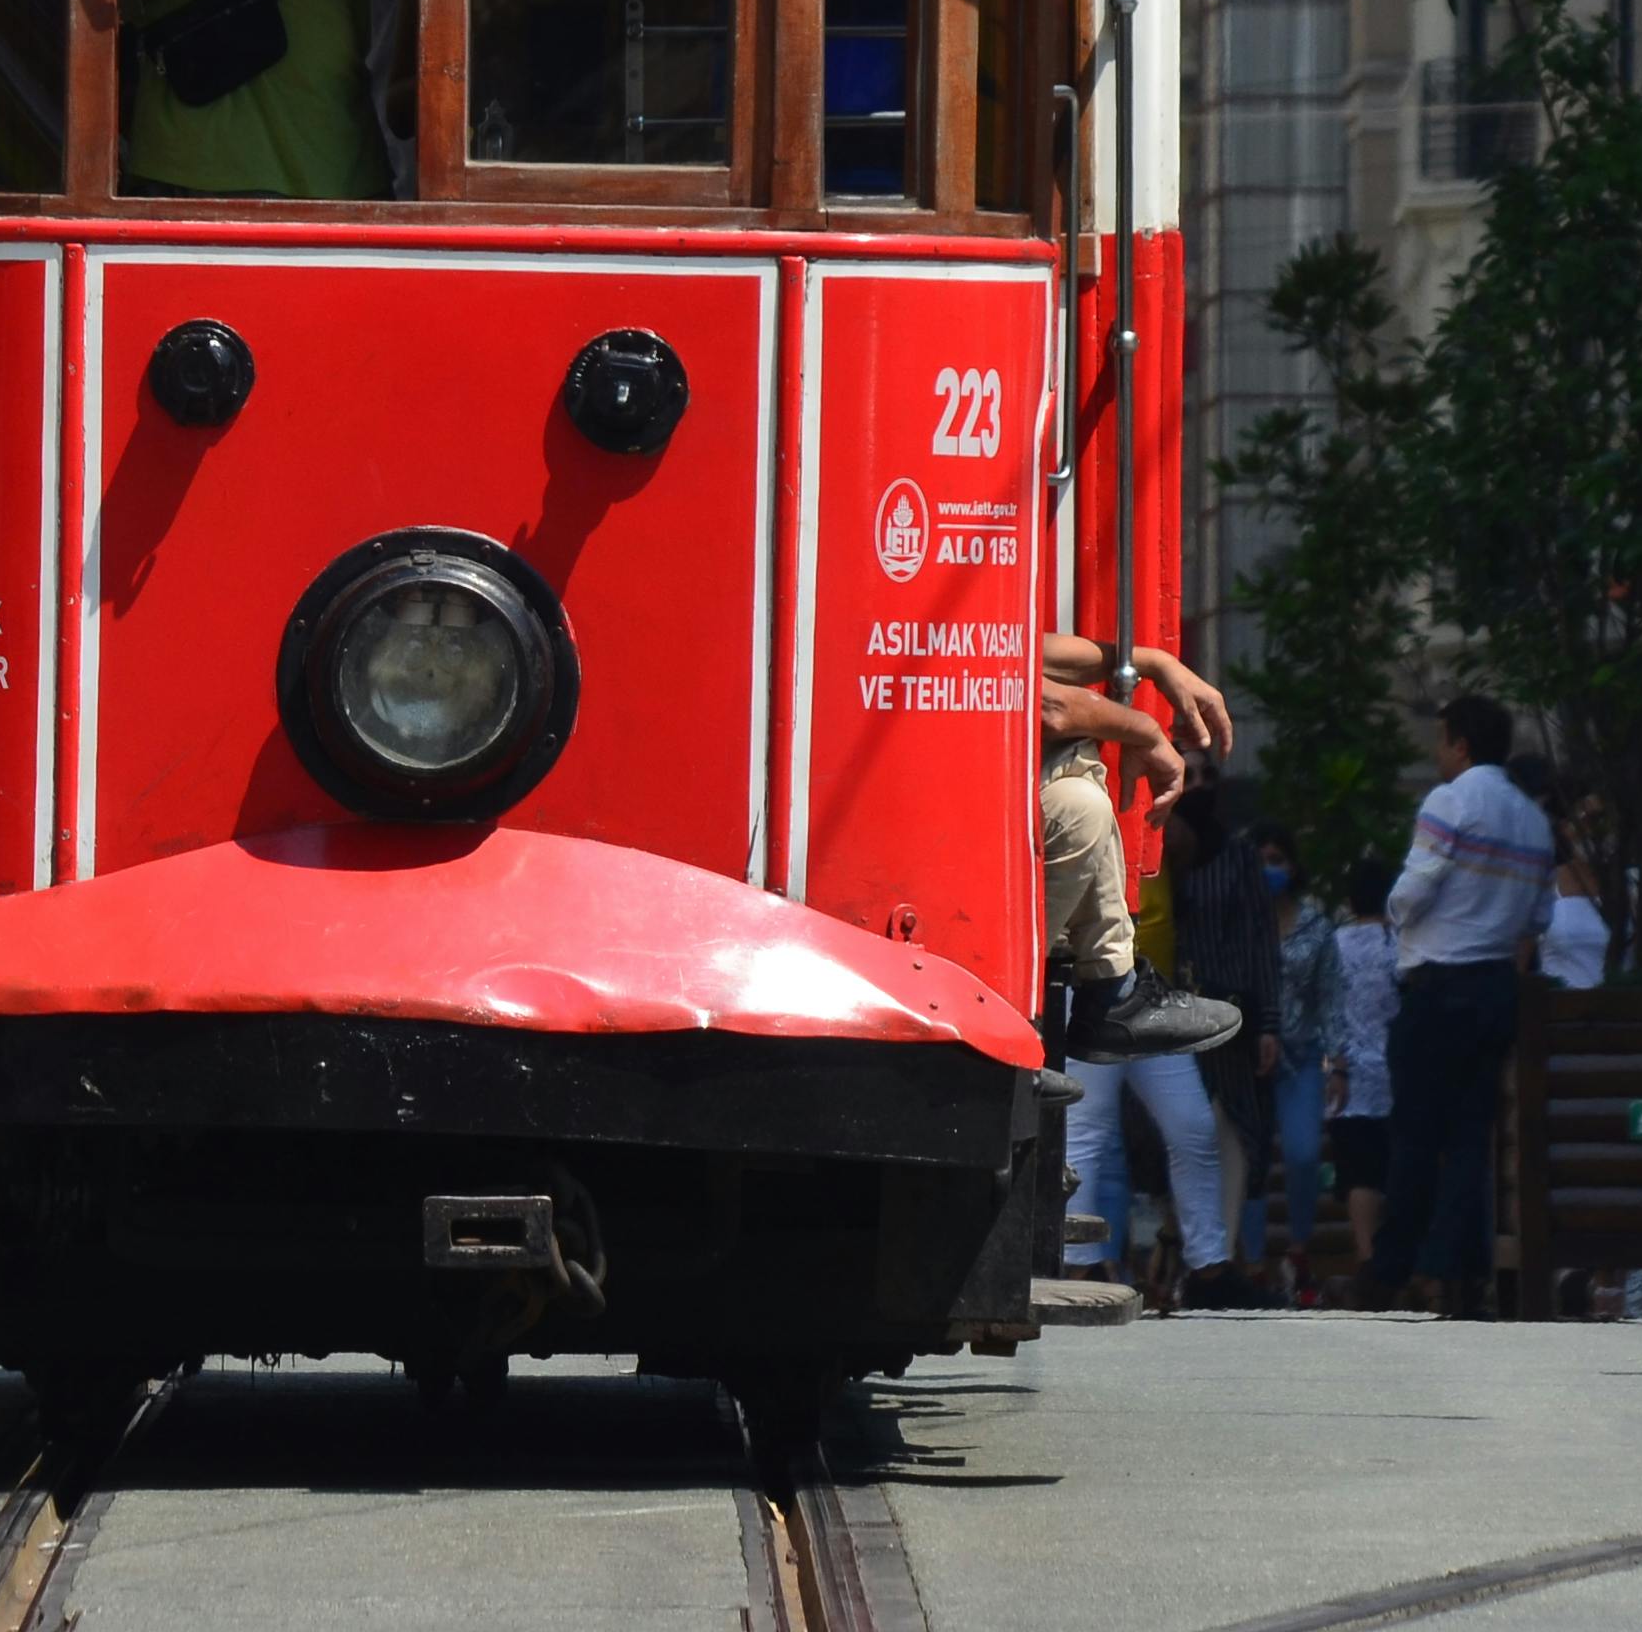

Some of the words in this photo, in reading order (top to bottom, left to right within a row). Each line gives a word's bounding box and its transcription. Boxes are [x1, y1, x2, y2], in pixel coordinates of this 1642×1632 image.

[932, 367, 1002, 459] 223
[937, 500, 1018, 519] www.iett.gov.tr
[936, 535, 985, 565] ALO
[989, 536, 1018, 566] 153
[867, 621, 976, 657] ASILMAK
[979, 623, 1025, 658] YASAK
[859, 675, 895, 710] VE
[901, 669, 1025, 713] TEHLİKELİDİR
